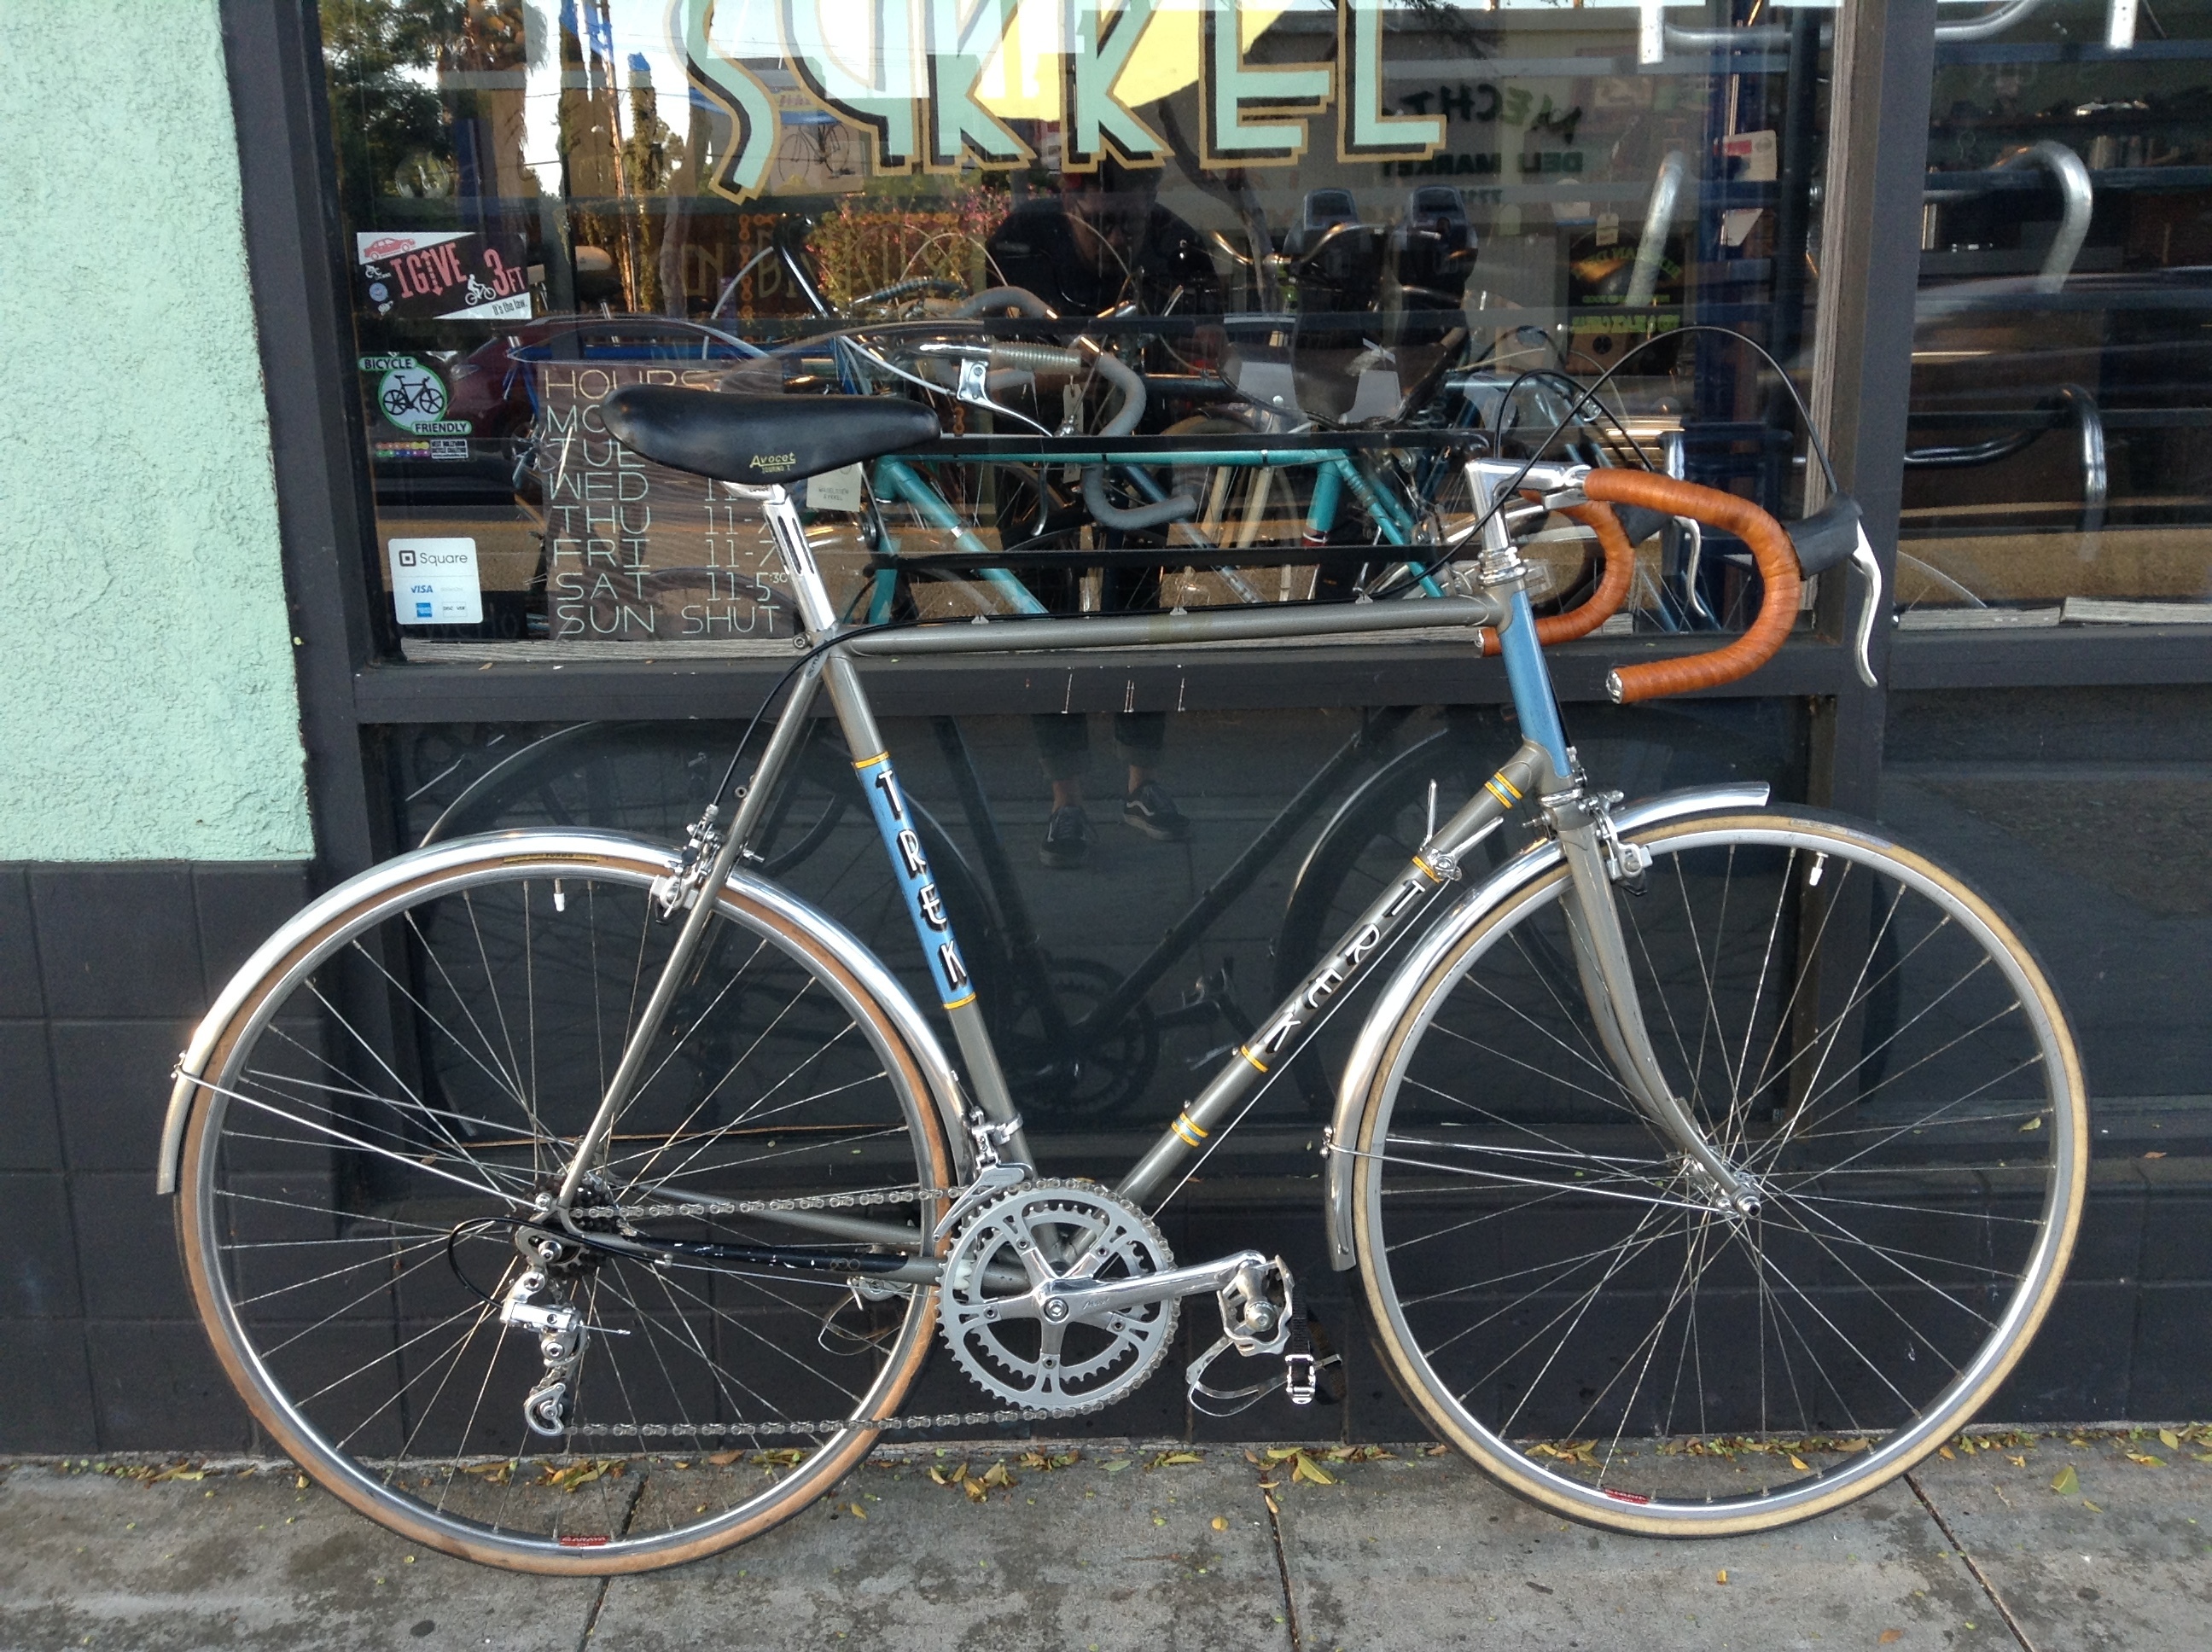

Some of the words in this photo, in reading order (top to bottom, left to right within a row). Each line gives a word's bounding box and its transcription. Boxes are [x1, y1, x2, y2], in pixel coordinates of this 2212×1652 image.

[364, 358, 413, 369] BICYCLE
[415, 422, 467, 433] FRIENDLY
[546, 404, 606, 433] MO
[550, 438, 646, 468] TUE
[749, 452, 797, 468] Avocet
[549, 472, 649, 502] WED
[552, 505, 651, 535] THU
[419, 552, 468, 567] Square
[553, 538, 651, 568] FRI
[410, 585, 434, 594] VISA
[556, 572, 651, 602] SAT
[556, 604, 655, 635] SUN
[681, 605, 781, 635] SHUT
[876, 770, 971, 992] TREK
[1254, 878, 1426, 1054] TREK
